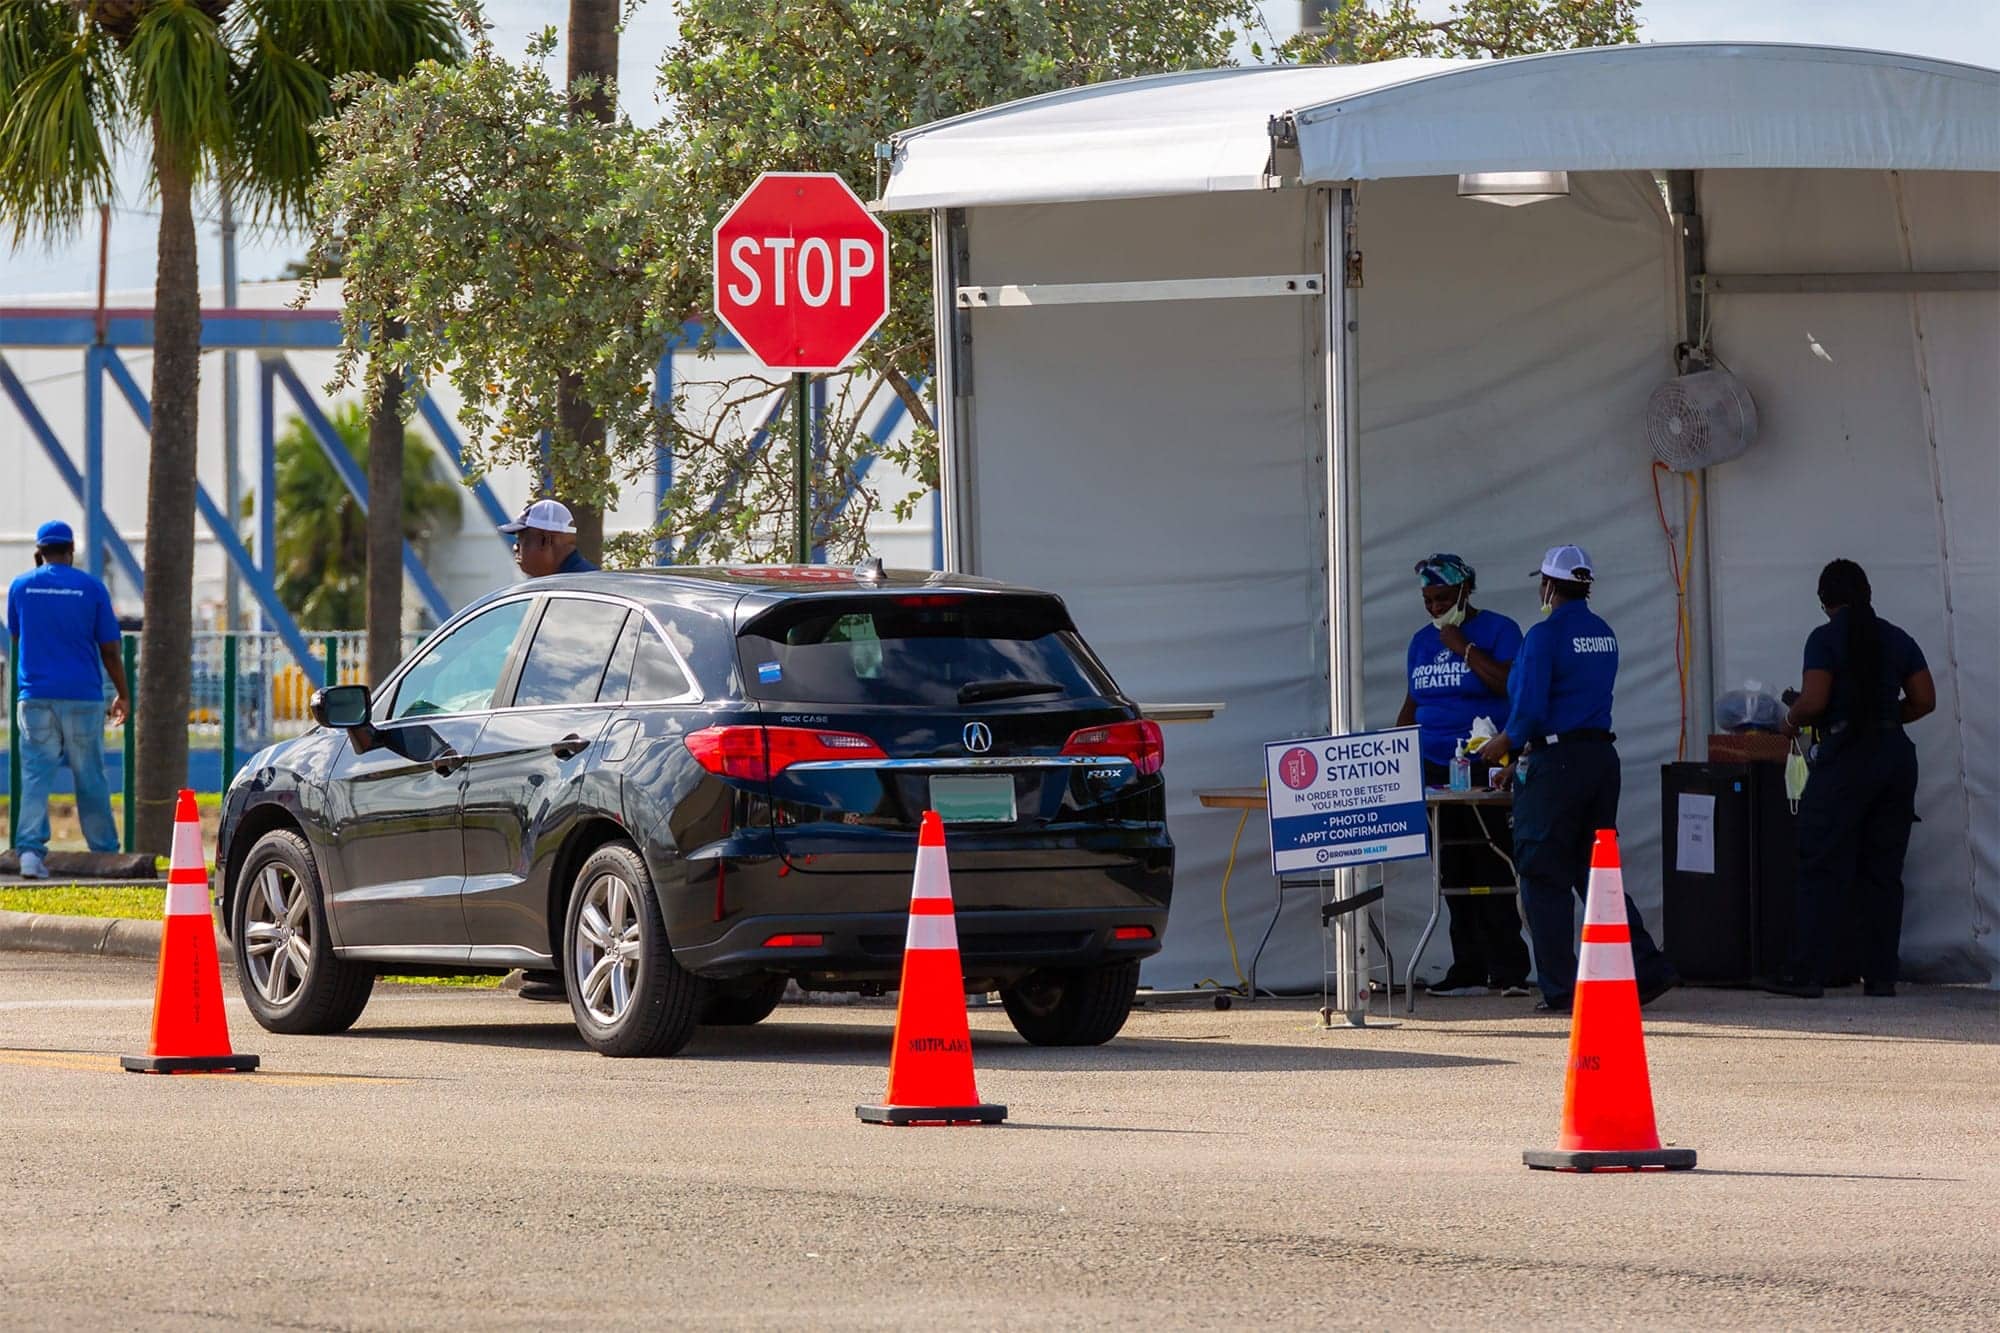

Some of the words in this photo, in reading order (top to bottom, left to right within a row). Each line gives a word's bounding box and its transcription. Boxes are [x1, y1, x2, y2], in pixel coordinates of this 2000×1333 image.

[728, 236, 875, 307] STOP
[1414, 674, 1461, 690] HEALTH
[781, 715, 801, 723] RICK
[802, 715, 828, 723] CASE
[1325, 738, 1409, 762] CHECK-IN
[1327, 759, 1400, 782] STATION
[1295, 794, 1304, 803] IN
[1307, 790, 1338, 802] ORDER
[1340, 788, 1352, 798] TO
[1354, 786, 1366, 796] BE
[1368, 783, 1400, 795] TESTED
[1312, 800, 1331, 811] YOU
[1333, 798, 1358, 809] MUST
[1329, 812, 1366, 827] PHOTO
[1368, 812, 1378, 823] ID
[1300, 830, 1329, 844] APPT
[1330, 821, 1407, 840] CONFIRMATION
